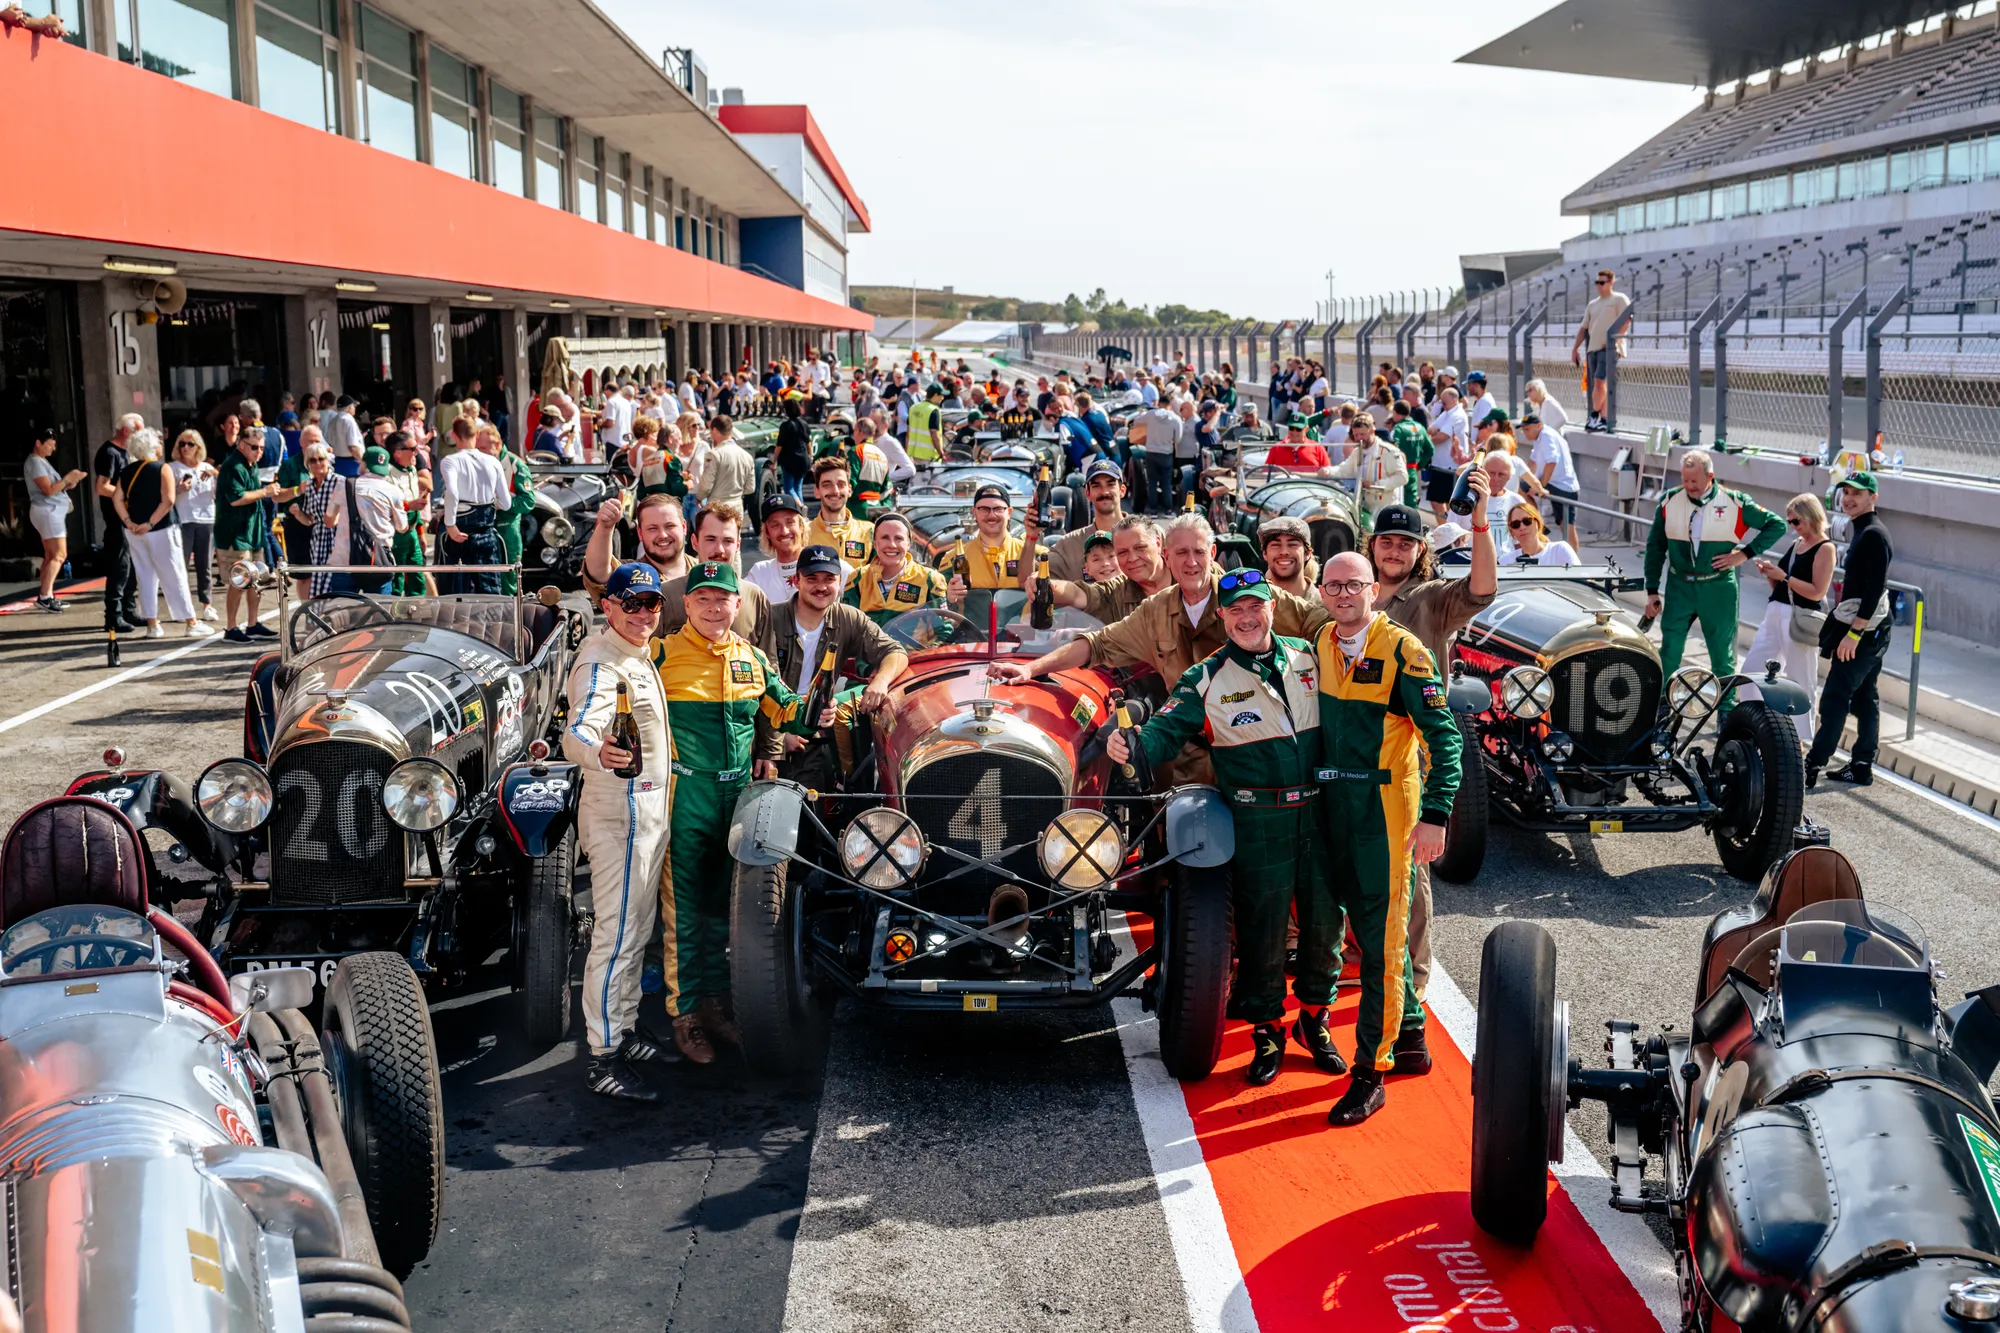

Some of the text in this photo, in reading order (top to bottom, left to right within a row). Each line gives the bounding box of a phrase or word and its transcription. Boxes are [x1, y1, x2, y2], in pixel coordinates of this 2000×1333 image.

[110, 311, 141, 375] 15
[309, 318, 331, 367] 14
[432, 322, 446, 363] 13
[631, 569, 653, 581] 24h
[1409, 664, 1430, 674] freem
[385, 671, 462, 746] 20
[1567, 662, 1642, 735] 19
[1348, 771, 1369, 779] Medcalf
[276, 769, 390, 861] 20
[947, 768, 1008, 862] 4
[973, 998, 987, 1008] TOW
